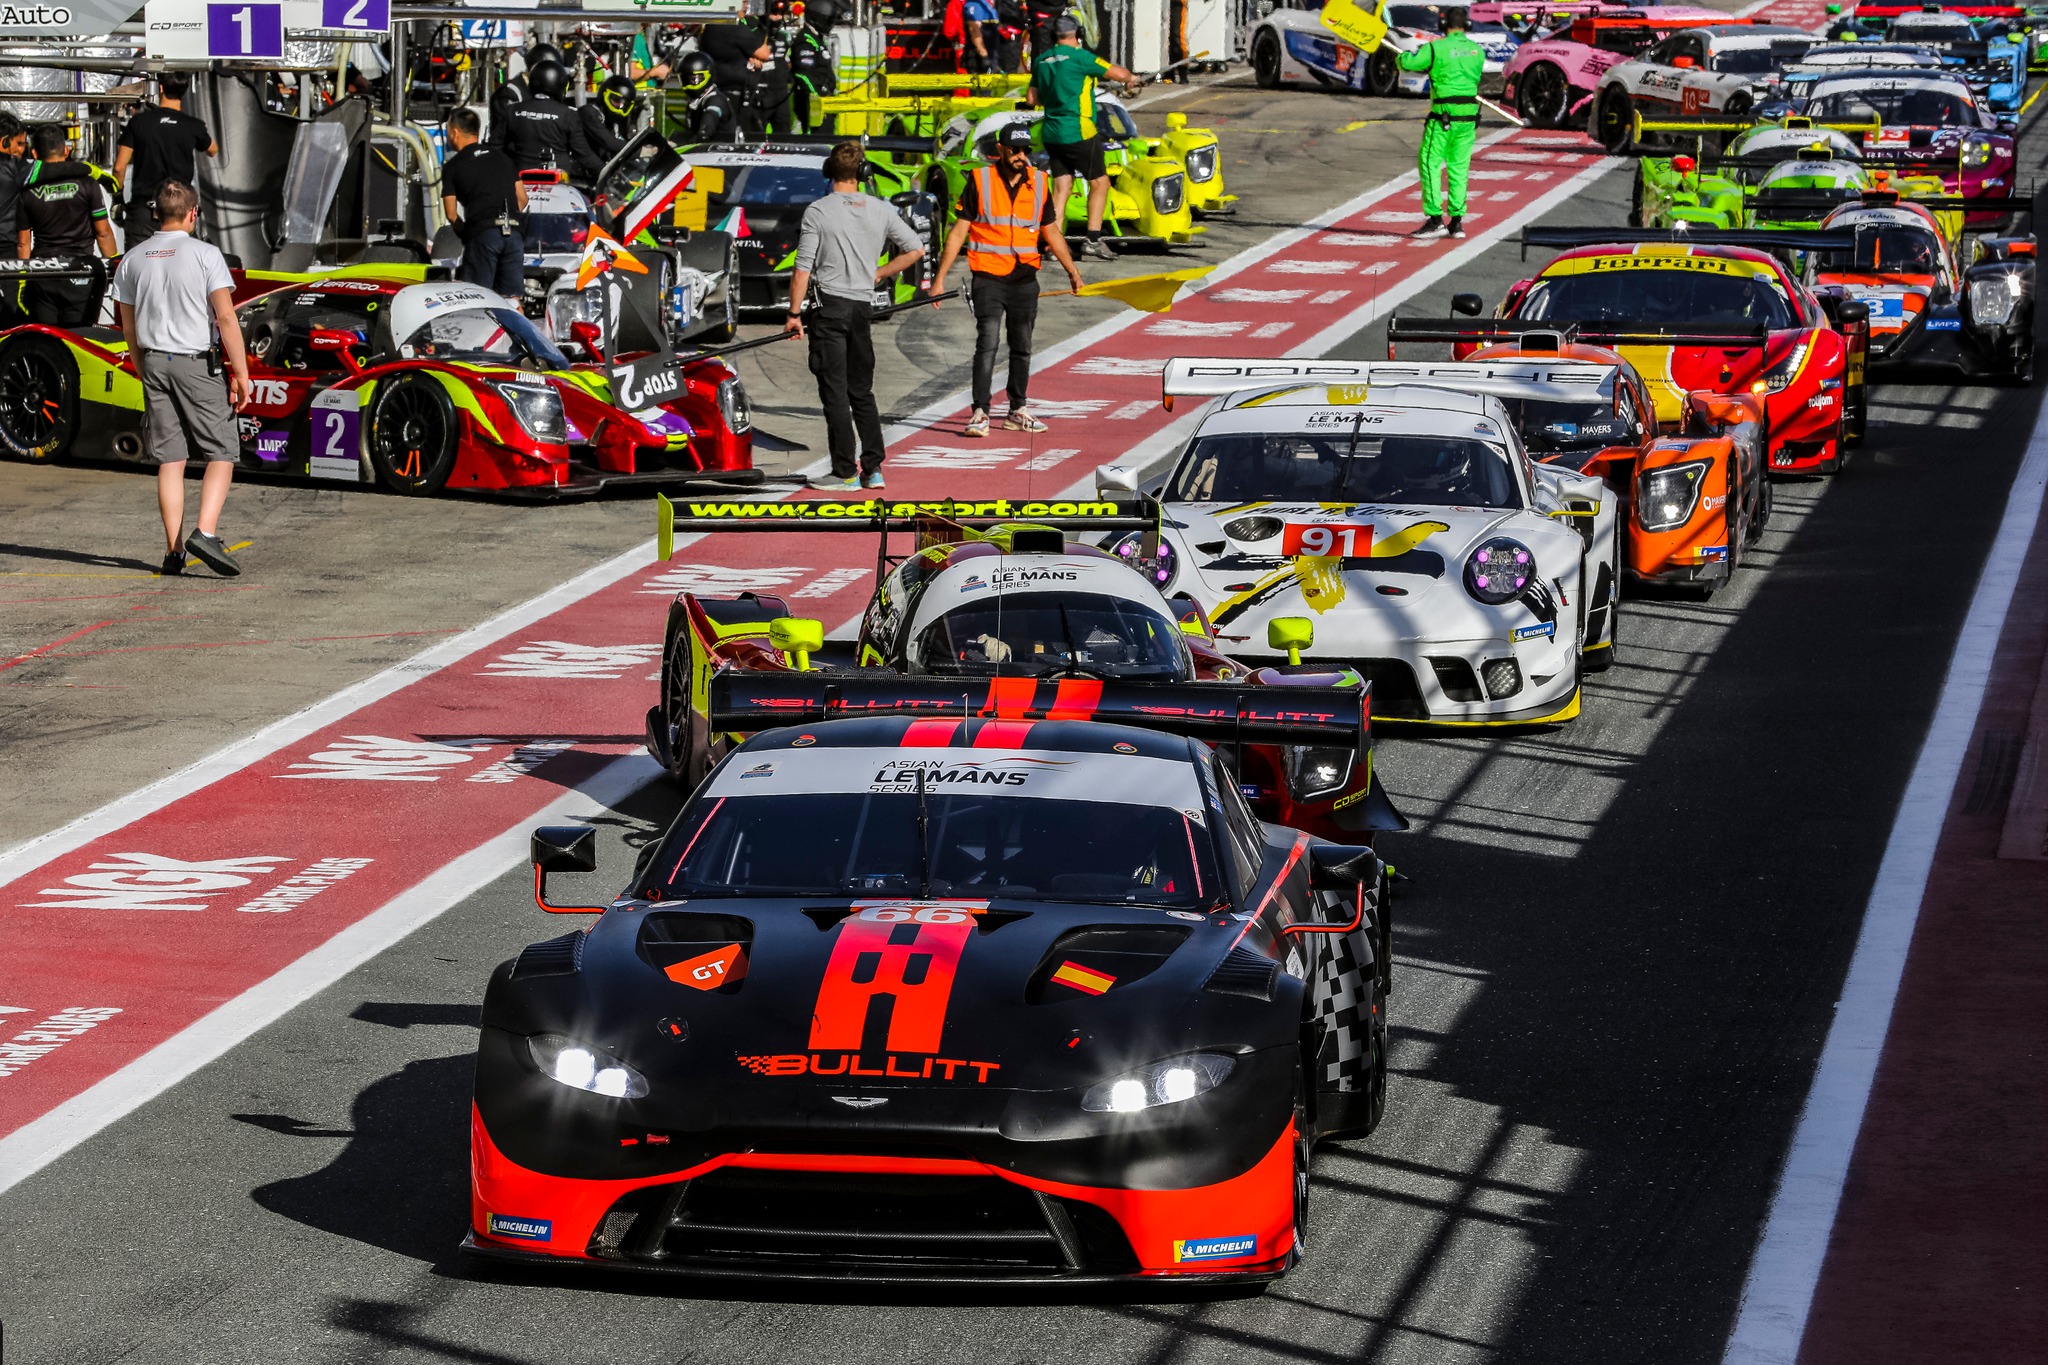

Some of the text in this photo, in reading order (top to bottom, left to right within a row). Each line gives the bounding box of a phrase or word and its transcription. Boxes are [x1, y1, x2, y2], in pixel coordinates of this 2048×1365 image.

[2, 6, 70, 25] Auto
[231, 7, 252, 54] 1
[1589, 257, 1730, 273] Ferrari
[643, 370, 678, 396] STOP
[1187, 365, 1603, 383] PORSCHE
[612, 364, 644, 409] 2
[1308, 416, 1331, 424] LE
[325, 412, 346, 456] 2
[1301, 527, 1357, 557] 91
[992, 566, 1026, 574] ASIAN
[992, 571, 1078, 584] LE MANS
[991, 581, 1032, 592] SERIES
[1523, 626, 1551, 637] MICHELIN
[882, 760, 944, 770] ASIAN
[873, 769, 1030, 787] LE MANS
[869, 784, 938, 794] SERIES
[16, 852, 297, 912] NGK
[858, 906, 969, 924] 66
[692, 959, 726, 981] GT
[766, 1054, 1001, 1084] BULLITT
[498, 1220, 548, 1235] MICHELIN
[1195, 1240, 1254, 1254] MICHELIN
